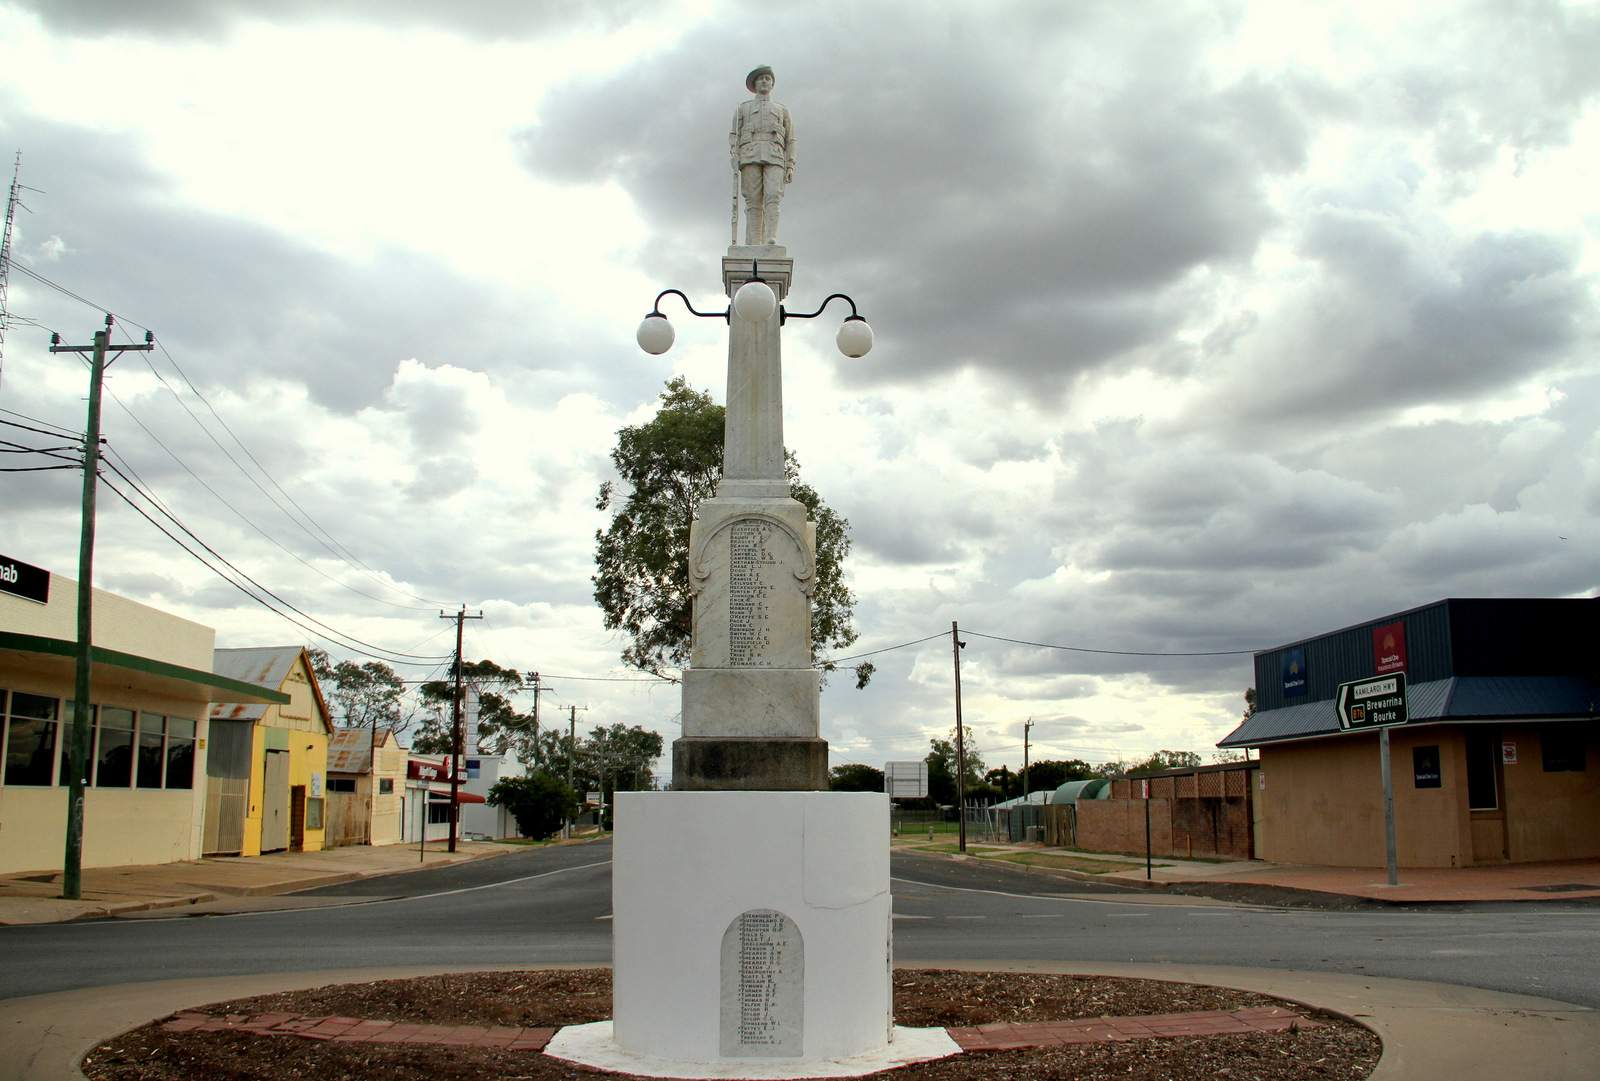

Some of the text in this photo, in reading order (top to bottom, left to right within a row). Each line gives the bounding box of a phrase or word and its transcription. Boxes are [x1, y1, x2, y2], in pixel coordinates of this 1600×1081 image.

[1382, 682, 1394, 691] HWY
[1366, 697, 1402, 710] Brewarrina
[1373, 712, 1396, 722] Bourke
